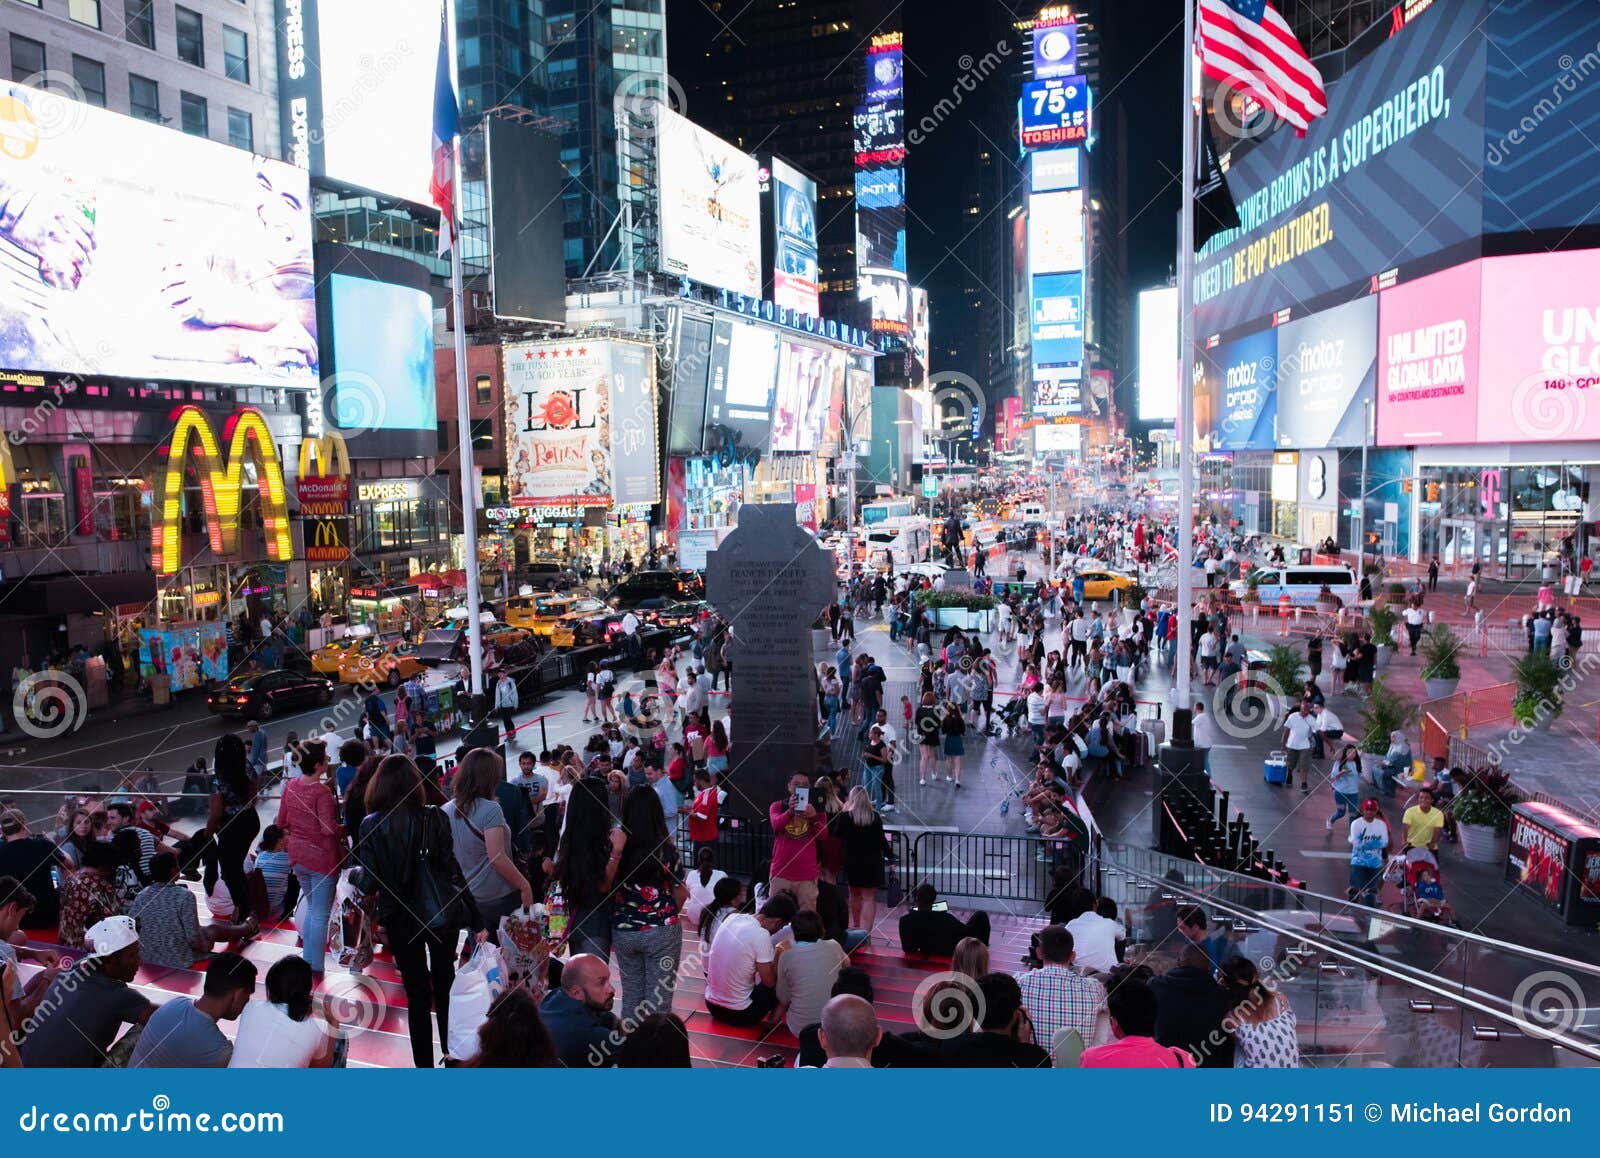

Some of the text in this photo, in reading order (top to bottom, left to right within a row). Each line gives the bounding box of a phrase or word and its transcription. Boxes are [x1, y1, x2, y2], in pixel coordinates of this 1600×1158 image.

[1034, 16, 1076, 29] TOSHIBA
[1022, 126, 1086, 144] TOSHIBA
[1270, 156, 1311, 218] BROWS
[1313, 146, 1327, 192] IS
[1328, 137, 1340, 183] A
[1342, 64, 1451, 174] SUPERHERO,
[1222, 256, 1234, 292] TO
[1234, 248, 1247, 287] BE
[1248, 237, 1267, 281] POP
[1269, 201, 1333, 269] CULTURED.
[720, 287, 775, 322] 1540
[778, 302, 869, 348] BROADWAY
[1388, 319, 1467, 366] UNLIMITED
[1388, 354, 1466, 392] GLOBAL DATA
[358, 484, 409, 501] EXPRESS
[485, 508, 520, 519] GITS
